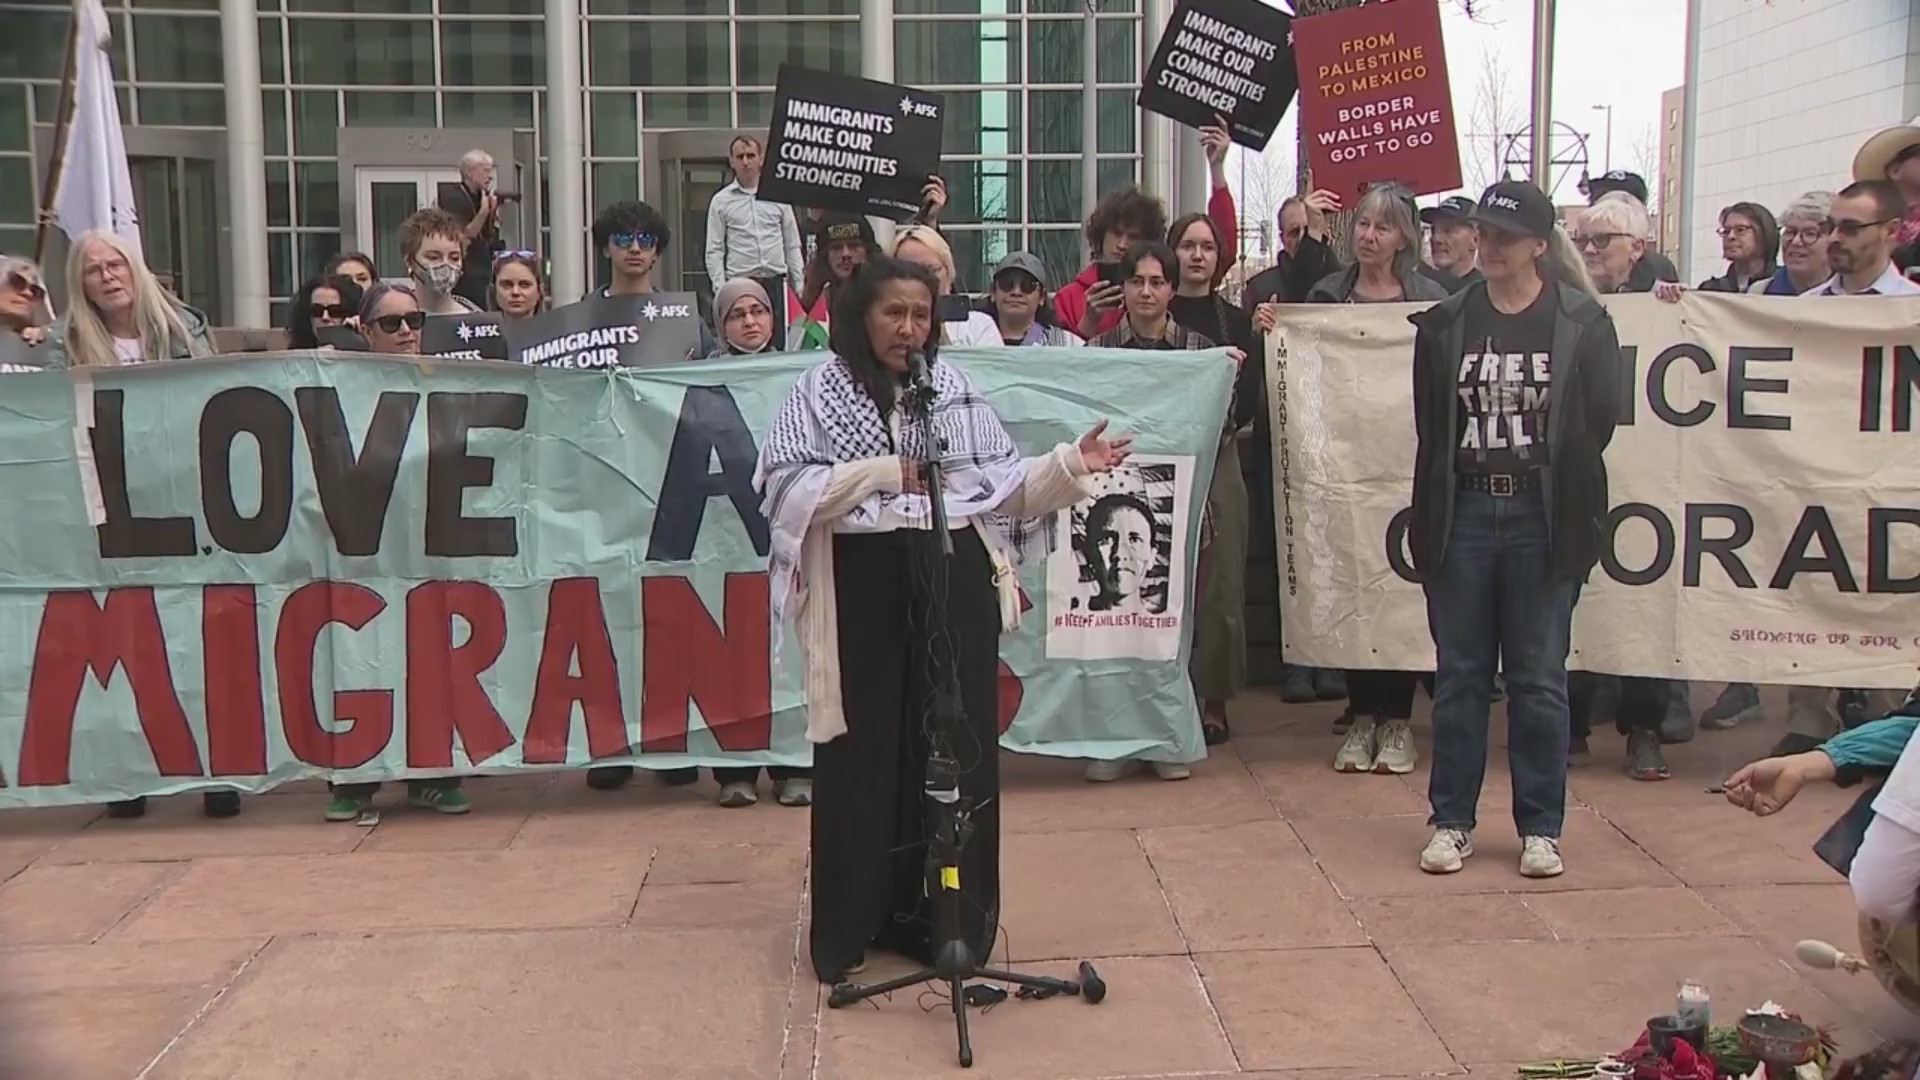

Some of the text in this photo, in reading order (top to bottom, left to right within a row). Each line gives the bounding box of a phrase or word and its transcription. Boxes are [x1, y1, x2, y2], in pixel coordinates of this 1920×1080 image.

[1184, 10, 1277, 61] IMMIGRANTS
[1341, 32, 1395, 55] FROM
[1175, 30, 1255, 75] MAKE OUR
[1319, 46, 1424, 79] PALESTINE
[1167, 51, 1266, 102] COMMUNITIES
[1320, 65, 1427, 97] TO MEXICO
[1157, 70, 1237, 114] STRONGER
[787, 99, 894, 134] IMMIGRANTS
[914, 103, 938, 118] AFSC
[1338, 96, 1414, 122] BORDER
[784, 121, 873, 151] MAKE OUR
[1318, 111, 1441, 145] WALLS HAVE
[780, 142, 898, 176] COMMUNITIES
[1330, 132, 1433, 162] GOT TO GO
[775, 162, 864, 191] STRONGER
[1496, 195, 1520, 211] AFSC
[660, 304, 690, 317] AFSC
[474, 324, 500, 338] AFSC
[522, 325, 640, 364] IMMIGRANTS
[577, 348, 620, 368] OUR
[1458, 353, 1551, 382] FREE
[1458, 386, 1550, 412] THEM
[90, 386, 528, 558] LOVE
[1287, 543, 1297, 596] TEAMS
[1826, 632, 1850, 645] UP
